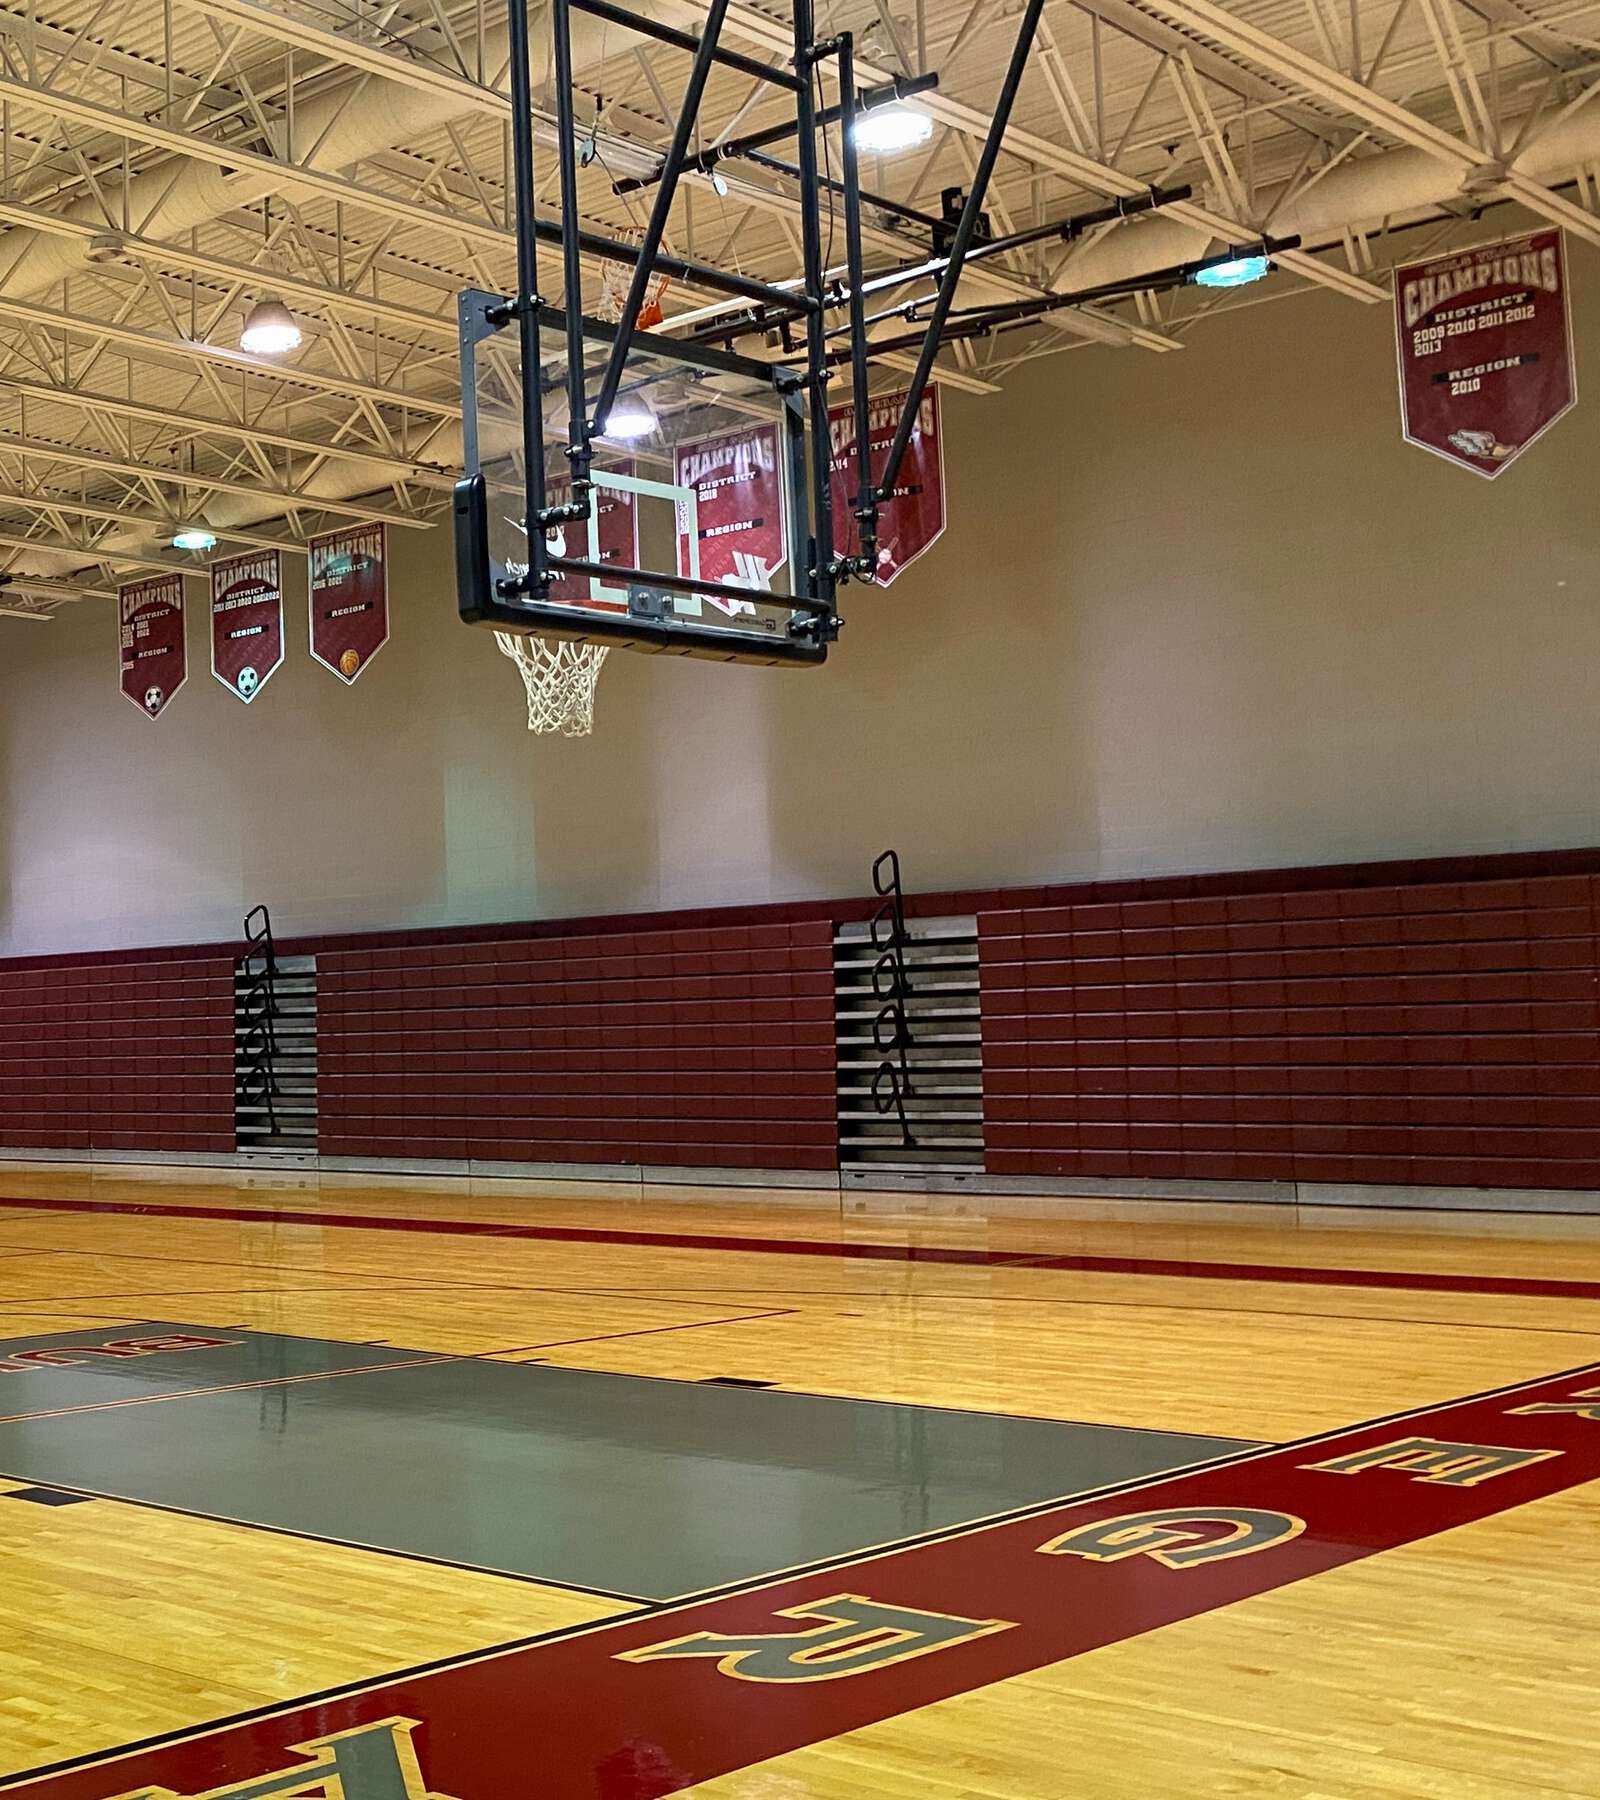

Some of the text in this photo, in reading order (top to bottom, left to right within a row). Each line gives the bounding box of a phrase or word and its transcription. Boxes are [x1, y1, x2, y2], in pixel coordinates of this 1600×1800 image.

[1404, 247, 1558, 327] CHAMPIONS
[1435, 292, 1527, 322] DISTRICT
[1413, 305, 1535, 343] 2009 2010 2011 2012
[1414, 339, 1442, 357] 2013
[1448, 356, 1520, 380] REGION
[1451, 378, 1481, 396] 2010
[680, 436, 774, 489] CHAMPIONS
[698, 471, 755, 490] DISTRICT
[706, 520, 753, 537] REGION
[313, 532, 382, 578] CHAMPIONS
[326, 561, 369, 577] DISTRICT
[215, 559, 277, 601] CHAMPIONS
[122, 582, 181, 622] CHAMPIONS
[226, 586, 266, 600] DISTRICT
[134, 608, 170, 622] DISTRICT
[331, 604, 365, 617] REGION
[231, 626, 262, 639] REGION
[138, 647, 167, 658] REGION
